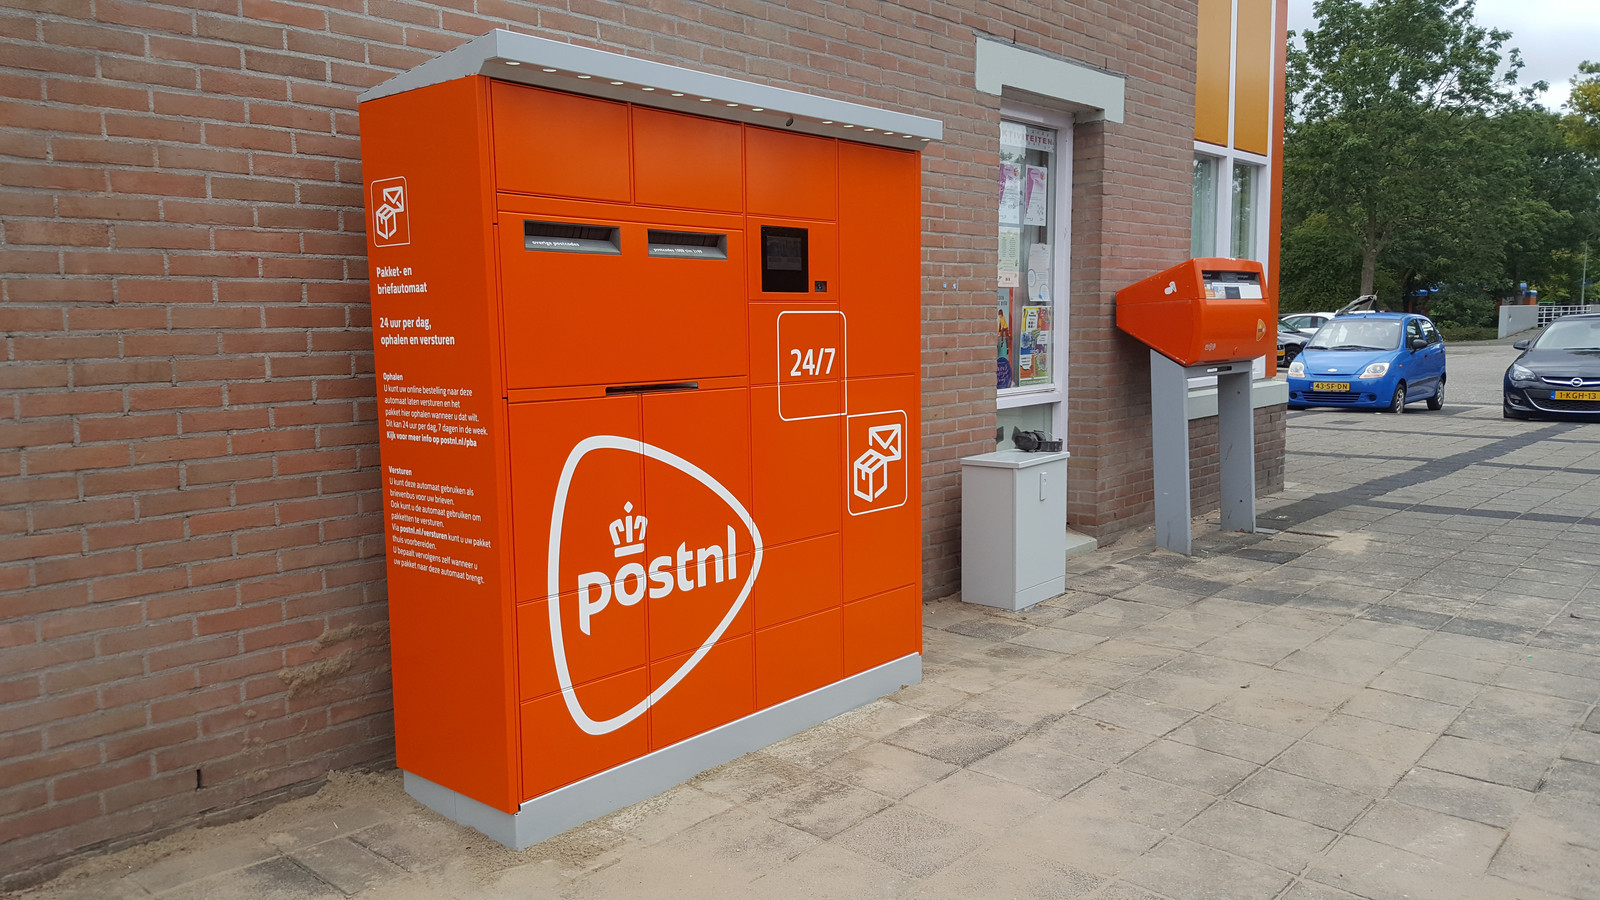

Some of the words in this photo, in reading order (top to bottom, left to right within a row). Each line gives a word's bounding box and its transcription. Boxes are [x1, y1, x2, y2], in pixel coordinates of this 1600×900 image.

[377, 267, 402, 278] Pakket-
[403, 267, 412, 276] en
[378, 282, 427, 294] briefautomaat
[380, 318, 388, 328] 24
[390, 319, 401, 327] uur
[403, 319, 414, 330] per
[416, 317, 431, 330] dag,
[381, 334, 408, 347] ophalen
[410, 336, 418, 344] en
[420, 335, 455, 345] versturen
[790, 348, 836, 376] 24/7
[383, 372, 403, 381] Ophalen
[384, 384, 387, 392] U
[407, 385, 421, 393] online
[423, 386, 446, 397] bestelling
[460, 388, 472, 396] deze
[452, 400, 460, 408] het
[385, 409, 400, 417] pakket
[411, 411, 431, 419] ophalen
[459, 413, 467, 421] dat
[468, 414, 479, 422] wilt.
[394, 420, 402, 428] kan
[418, 423, 426, 431] per
[427, 423, 437, 433] dag,
[442, 424, 458, 434] dagen
[459, 425, 464, 433] in
[465, 426, 472, 434] de
[473, 427, 488, 435] week.
[387, 431, 395, 440] Kijk
[433, 437, 439, 445] op
[441, 436, 477, 448] postnl.nl/pba
[389, 466, 412, 475] Versturen
[405, 480, 416, 488] deze
[417, 482, 440, 491] automaat
[441, 485, 466, 494] gebruiken
[390, 489, 415, 499] brievenbus
[435, 495, 454, 505] brieven.
[391, 500, 400, 508] Ook
[415, 504, 421, 512] de
[422, 506, 445, 515] automaat
[446, 510, 471, 520] gebruiken
[391, 513, 414, 522] pakketten
[421, 518, 444, 527] versturen.
[392, 535, 404, 543] thuis
[405, 538, 436, 549] voorbereiden.
[400, 525, 447, 539] postnl.nl/versturen
[448, 532, 460, 541] kunt
[473, 537, 491, 548] pakket
[398, 547, 415, 556] bepaalt
[416, 550, 441, 562] vervolgens
[452, 558, 473, 568] wanneer
[401, 560, 416, 568] pakket
[417, 563, 428, 571] naar
[429, 564, 440, 574] deze
[441, 568, 465, 579] automaat
[466, 572, 485, 584] brengt.
[578, 525, 737, 636] postnl
